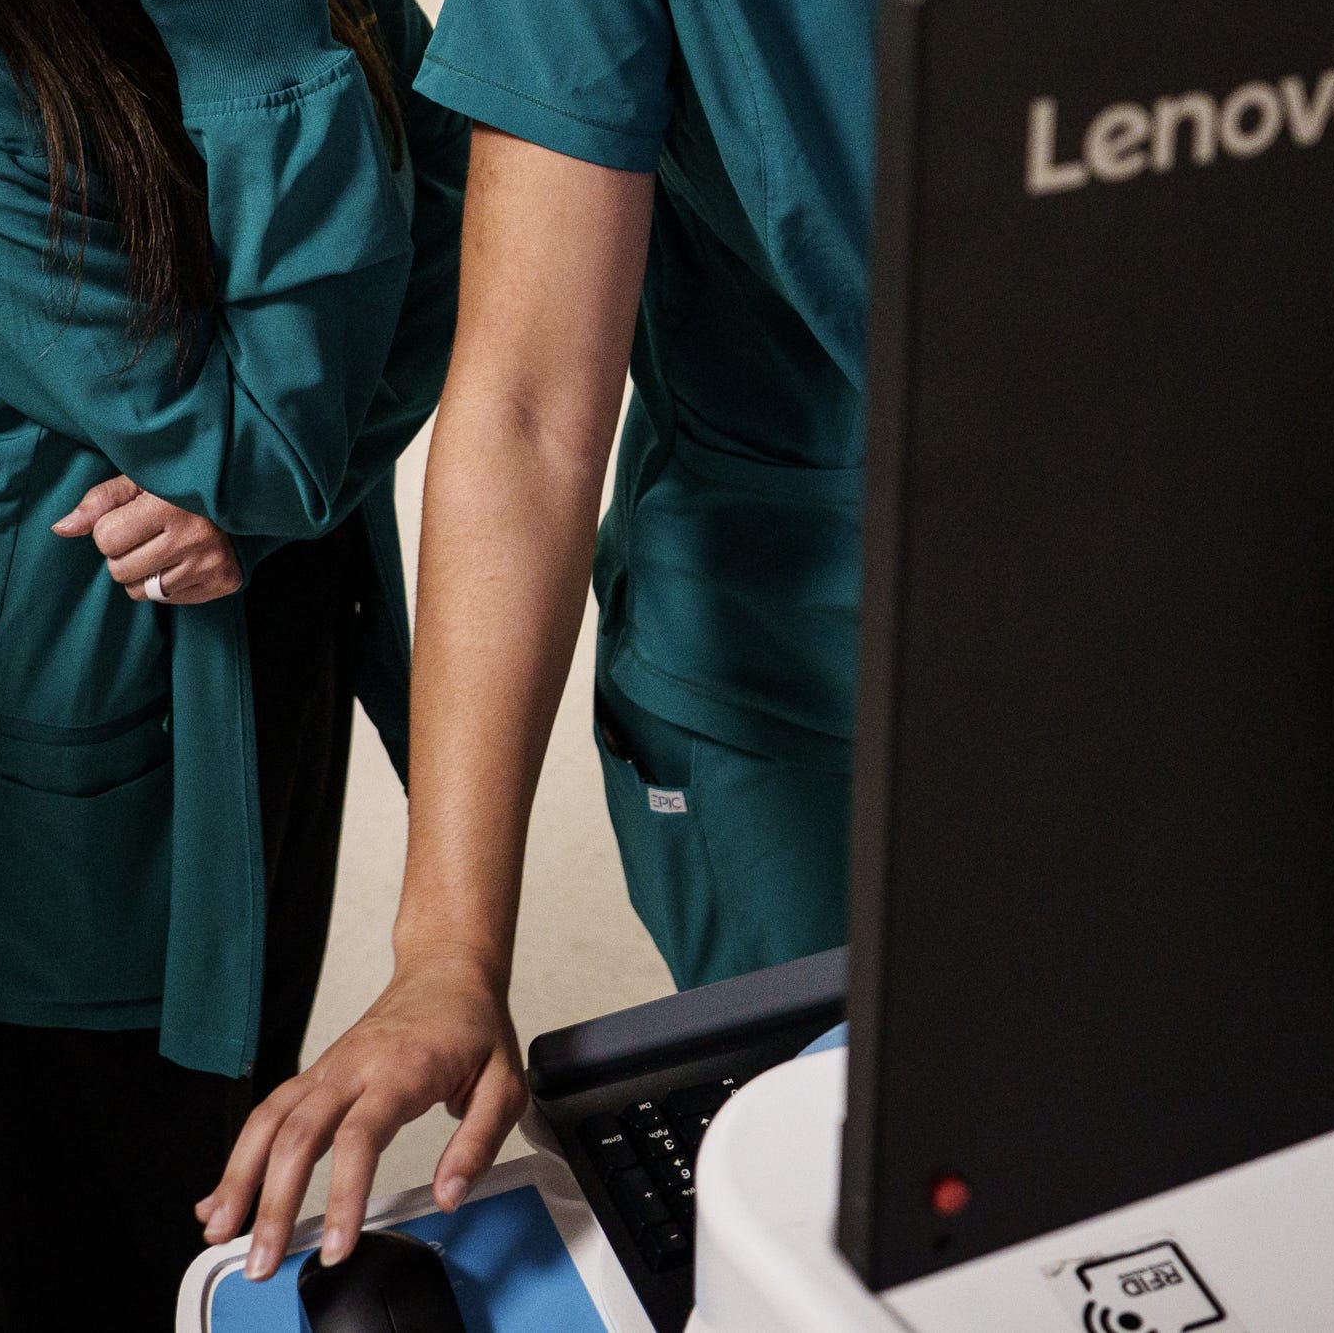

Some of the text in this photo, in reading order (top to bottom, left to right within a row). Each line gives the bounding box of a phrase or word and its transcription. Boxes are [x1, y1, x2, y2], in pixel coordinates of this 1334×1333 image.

[722, 1078, 734, 1086] Ins
[638, 1101, 652, 1111] Del
[648, 1128, 669, 1139] PgDn
[601, 1134, 623, 1145] Enter
[664, 1139, 675, 1150] 3
[680, 1168, 691, 1179] 6
[682, 1187, 696, 1196] gUp
[1121, 1264, 1183, 1297] RFID
